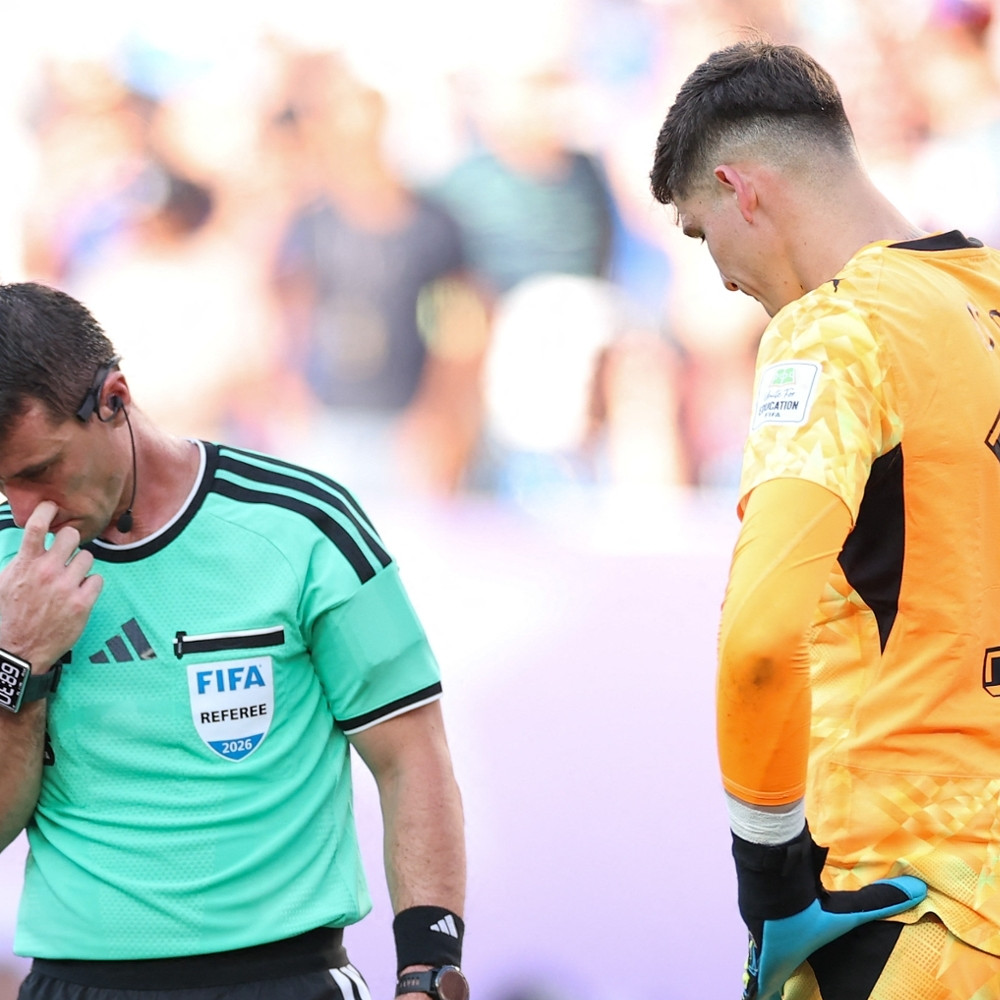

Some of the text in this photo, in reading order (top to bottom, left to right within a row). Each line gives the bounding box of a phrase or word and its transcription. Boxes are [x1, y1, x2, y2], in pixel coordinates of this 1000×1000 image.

[196, 665, 266, 695] FIFA
[200, 703, 268, 724] REFEREE
[222, 738, 253, 754] 2026
